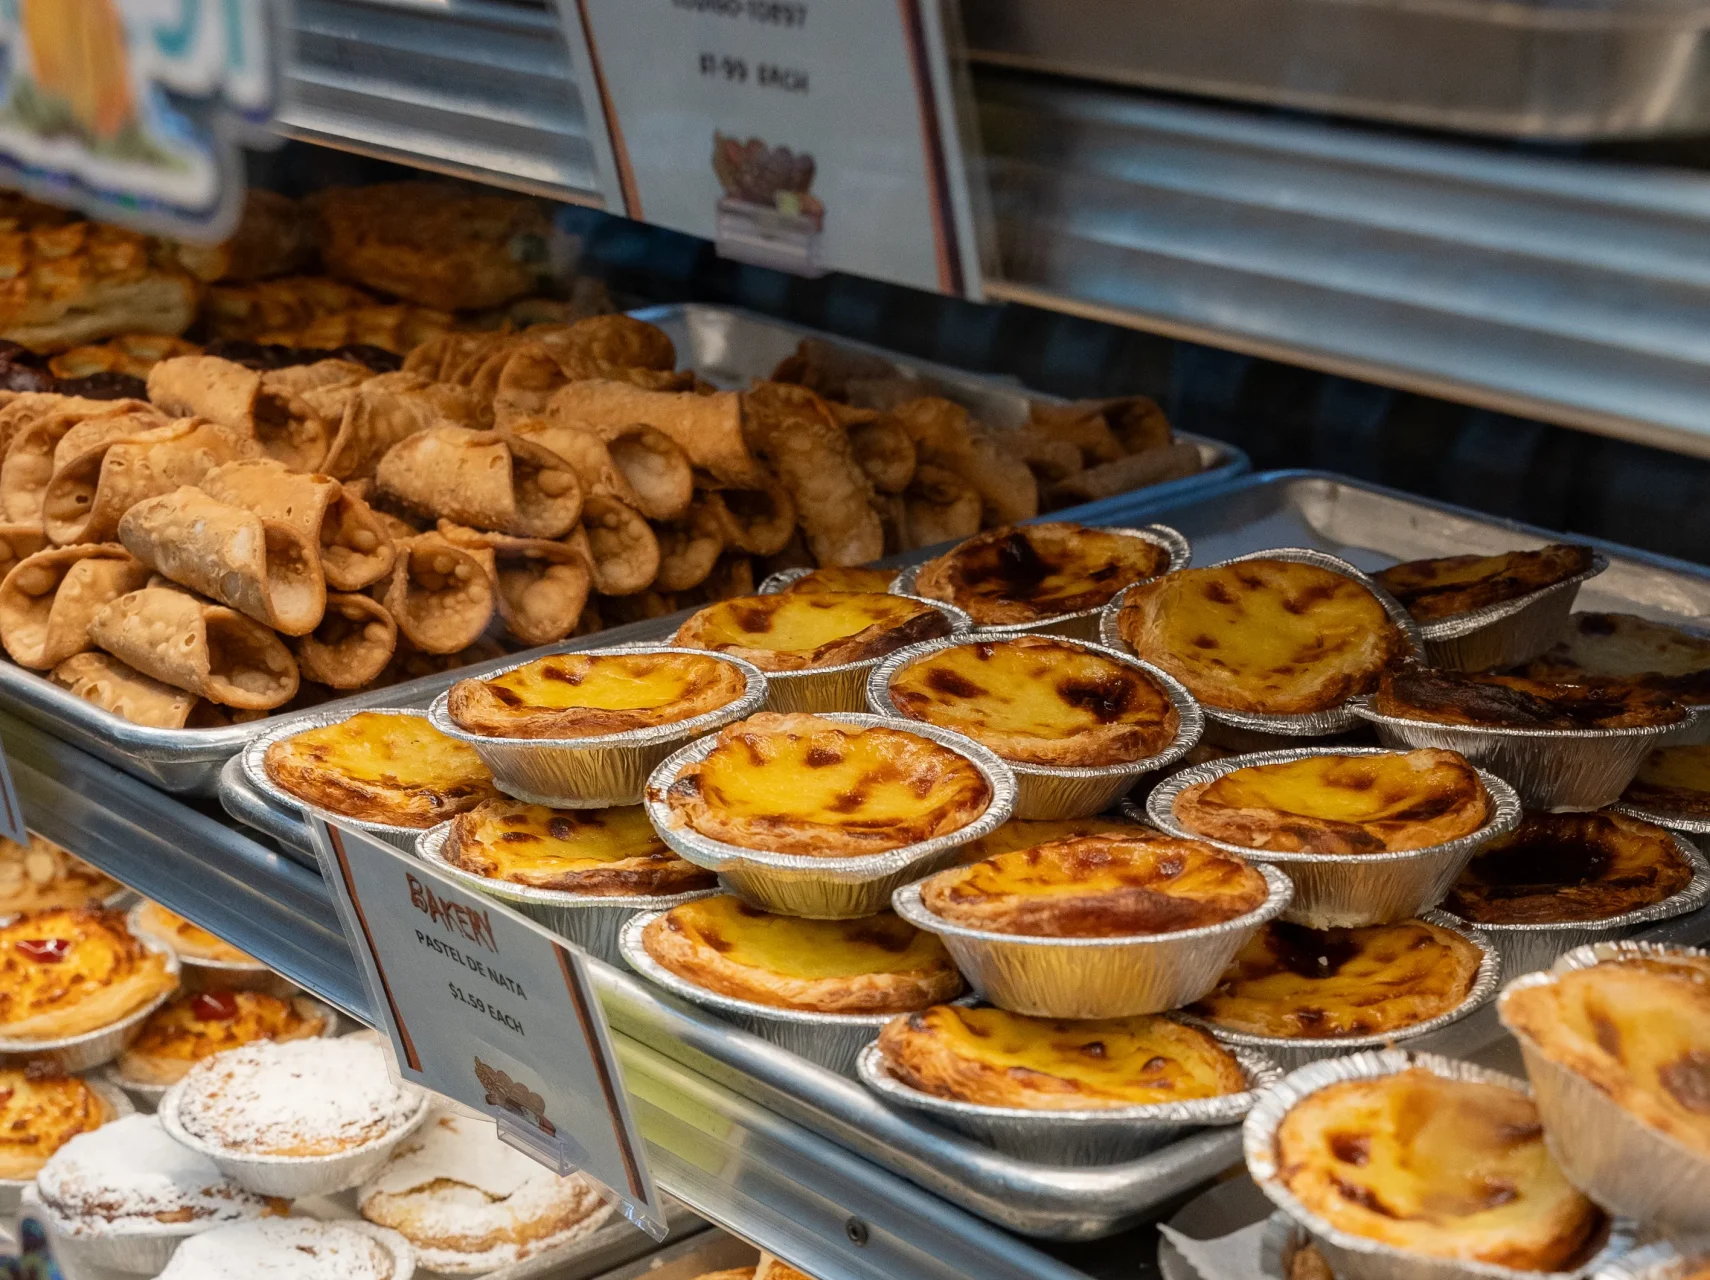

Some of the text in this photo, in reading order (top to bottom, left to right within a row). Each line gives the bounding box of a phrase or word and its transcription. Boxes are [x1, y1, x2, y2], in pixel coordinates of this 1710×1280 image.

[405, 872, 499, 954] BAKERY
[415, 929, 528, 1000] PASTEL DE NATA
[448, 981, 525, 1036] $1.59 EACH
